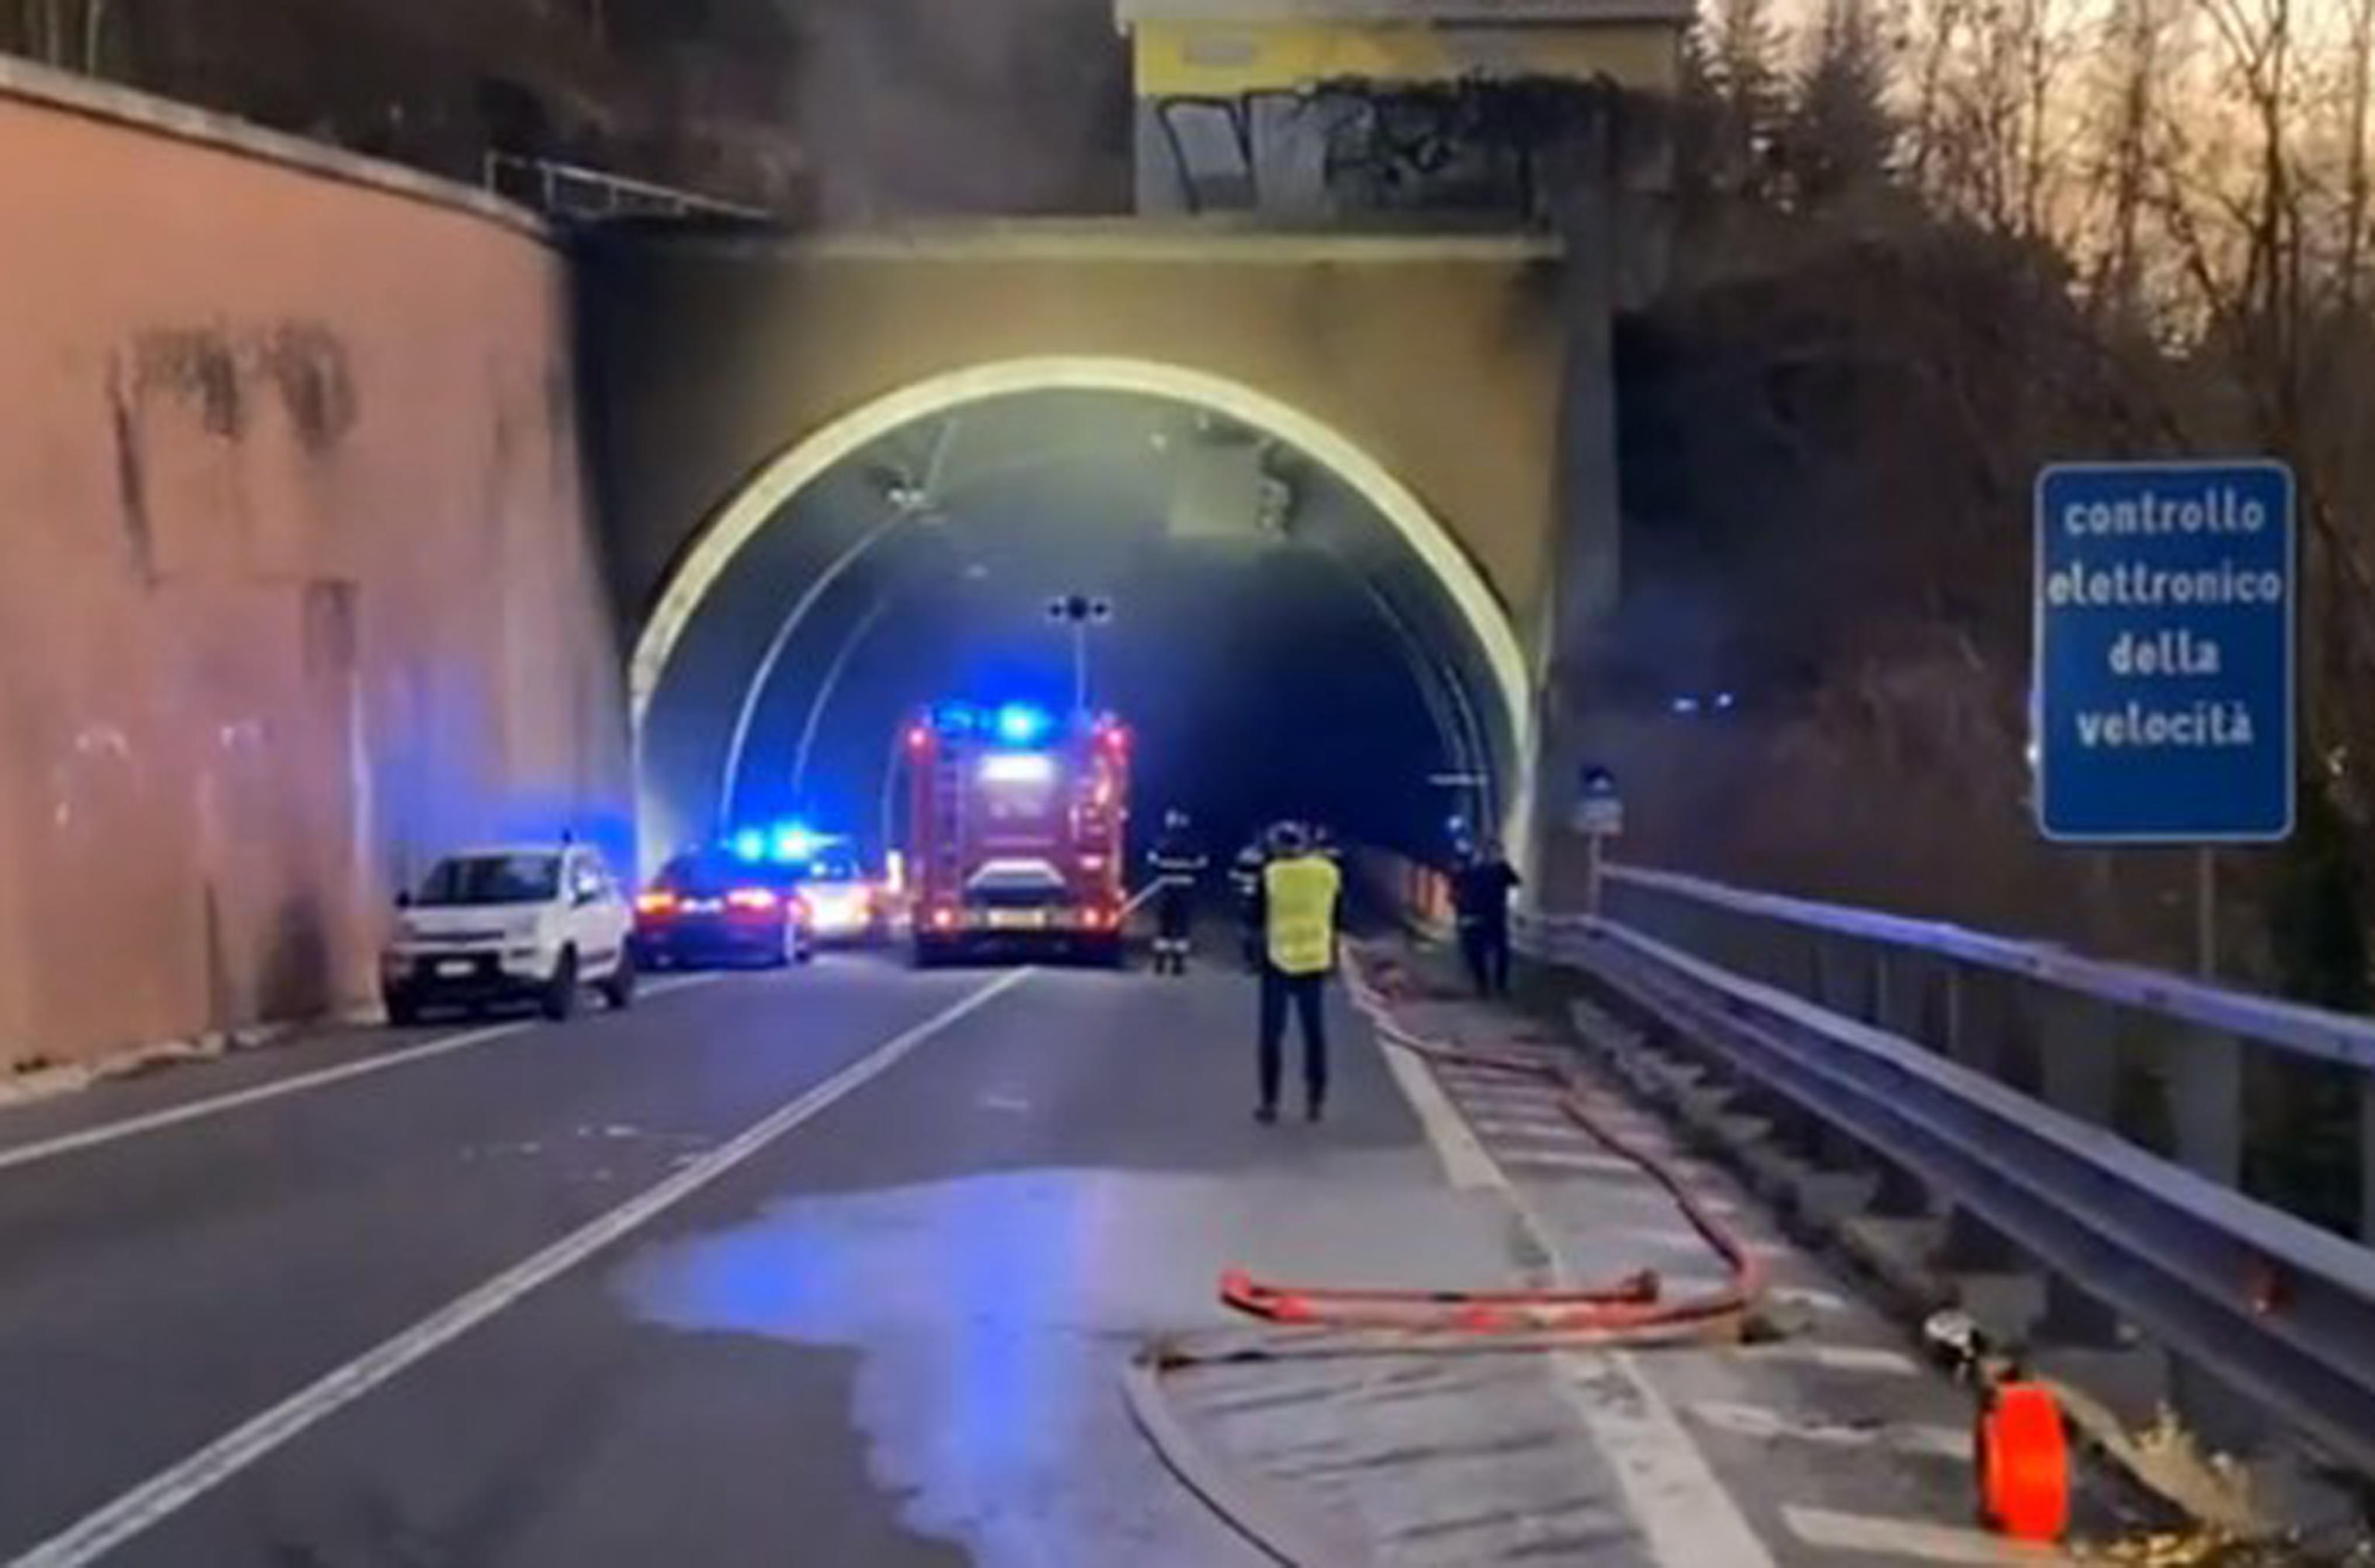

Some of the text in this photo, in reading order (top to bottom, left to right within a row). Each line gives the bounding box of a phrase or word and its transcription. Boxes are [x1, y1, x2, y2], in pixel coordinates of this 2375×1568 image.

[2063, 489, 2264, 533] controllo
[2048, 561, 2282, 605] elettronico
[2108, 630, 2220, 675] della
[2076, 701, 2254, 747] velocità
